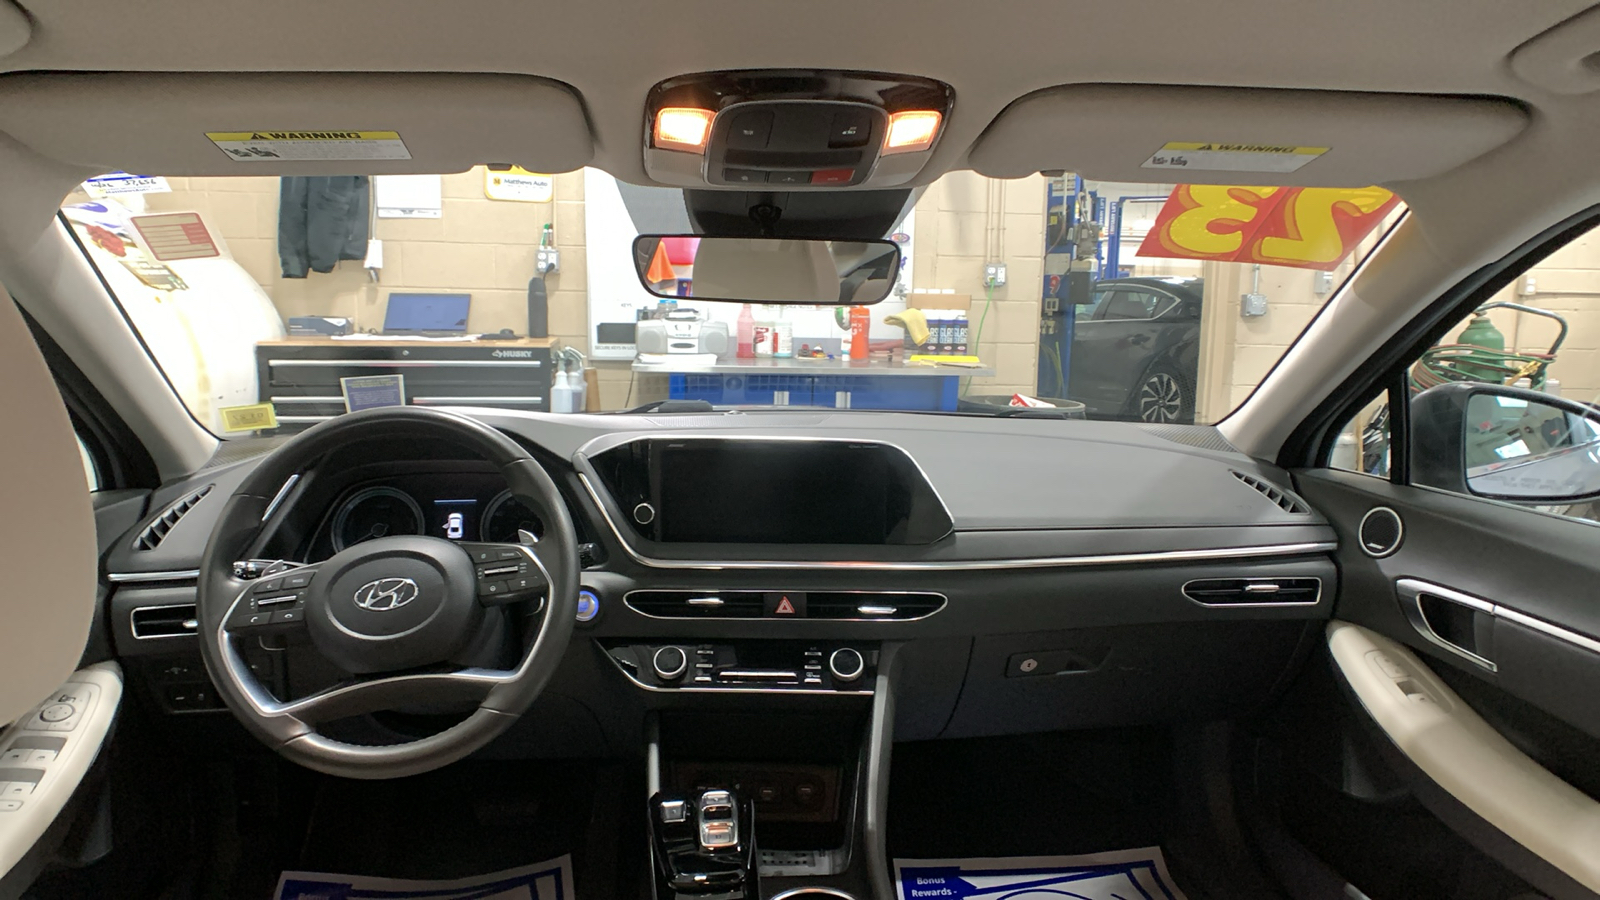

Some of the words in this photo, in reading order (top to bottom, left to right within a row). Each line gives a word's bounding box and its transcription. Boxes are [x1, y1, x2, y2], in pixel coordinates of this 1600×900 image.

[1218, 144, 1297, 153] WARNING
[504, 178, 532, 186] Matthews
[916, 877, 945, 885] Bonus
[911, 887, 952, 897] Rewards
